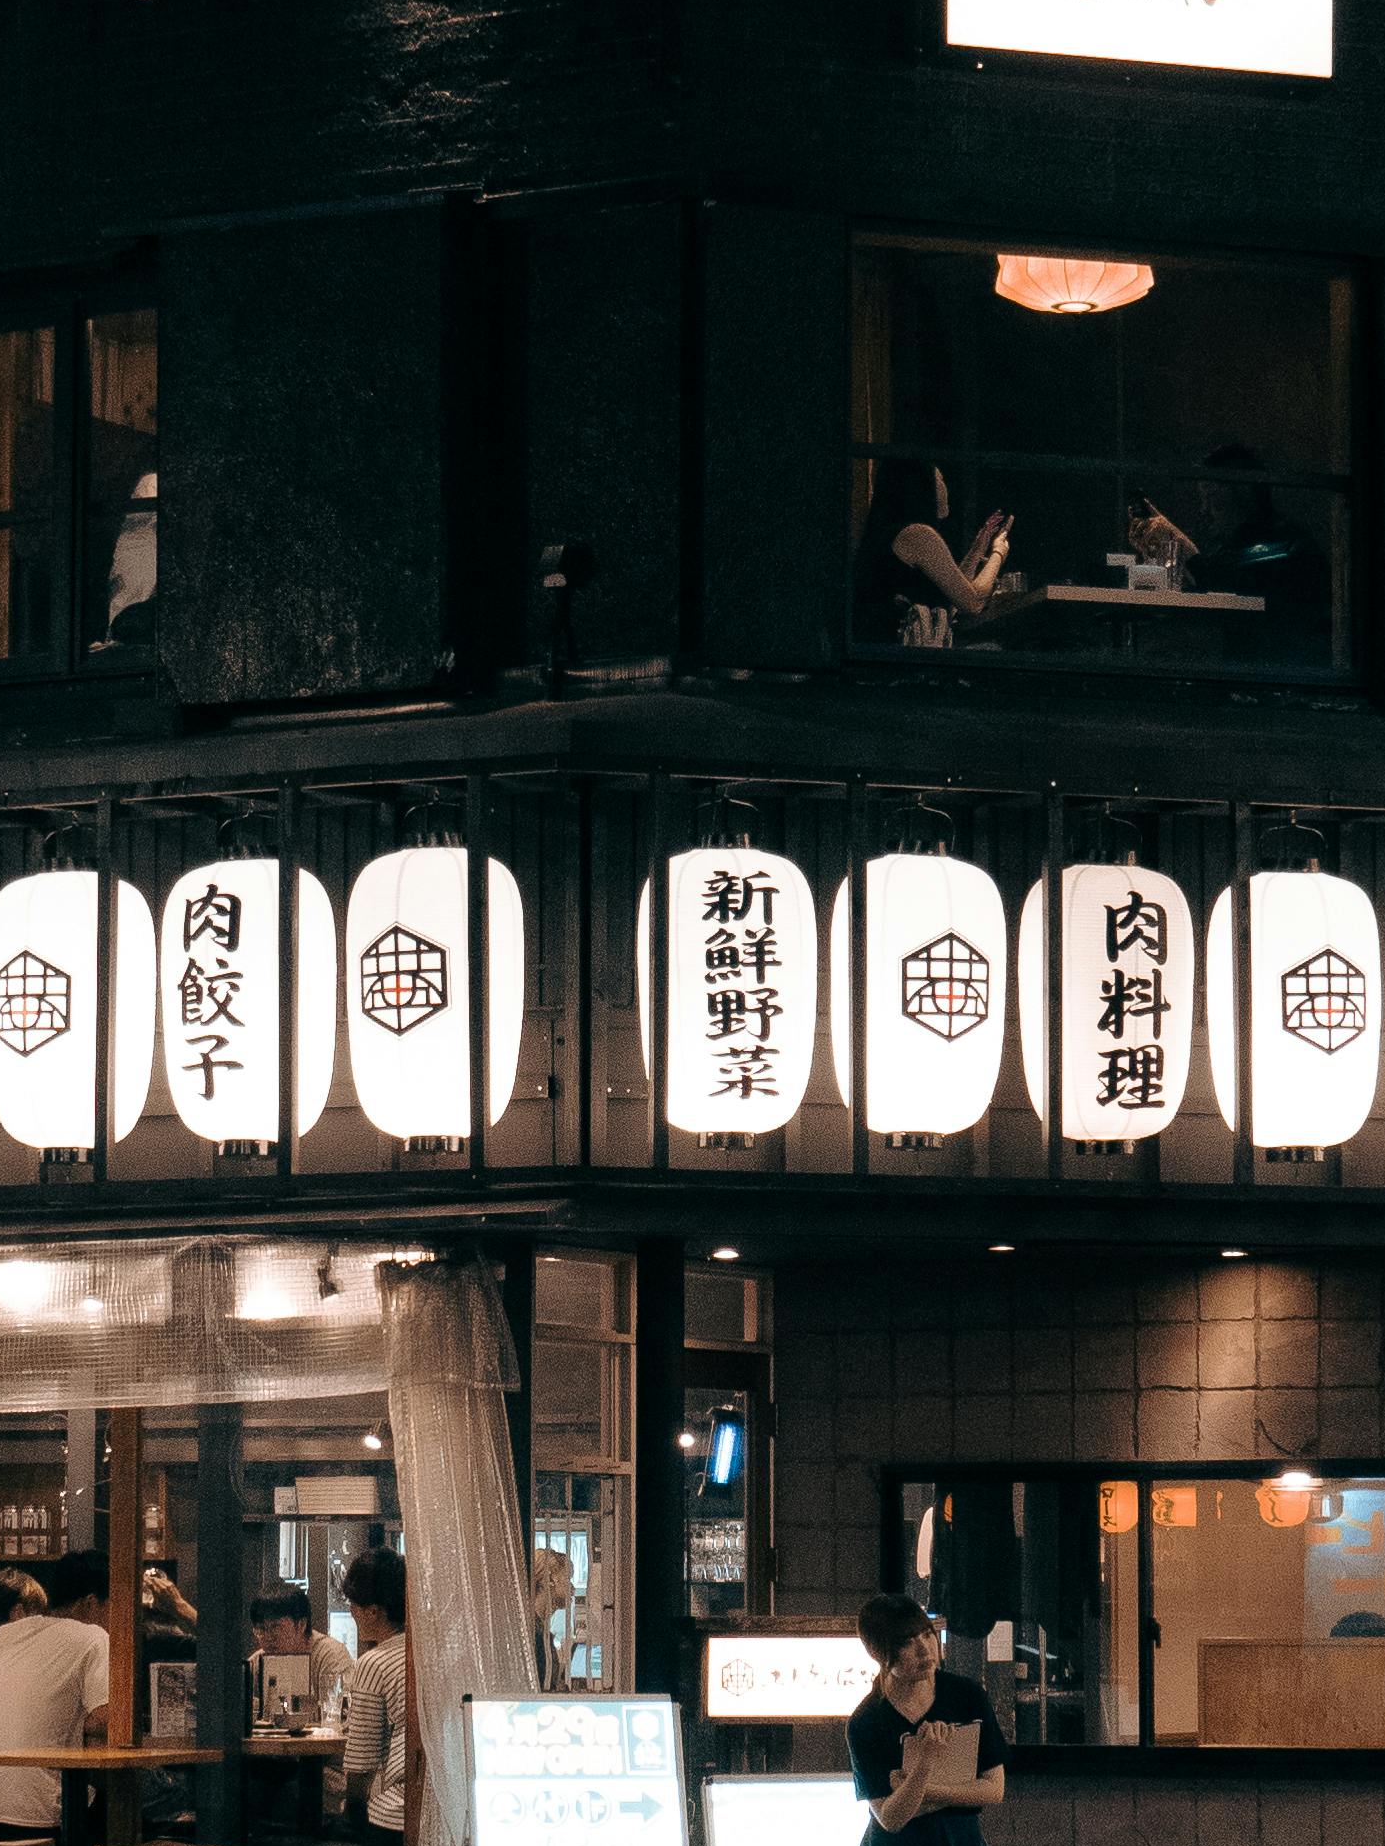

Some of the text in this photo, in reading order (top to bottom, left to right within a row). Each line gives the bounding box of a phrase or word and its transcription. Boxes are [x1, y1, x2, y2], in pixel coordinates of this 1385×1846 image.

[176, 884, 246, 1102] 肉餃子
[699, 869, 785, 1101] 新鮮野菜
[1095, 890, 1171, 1110] 肉料理
